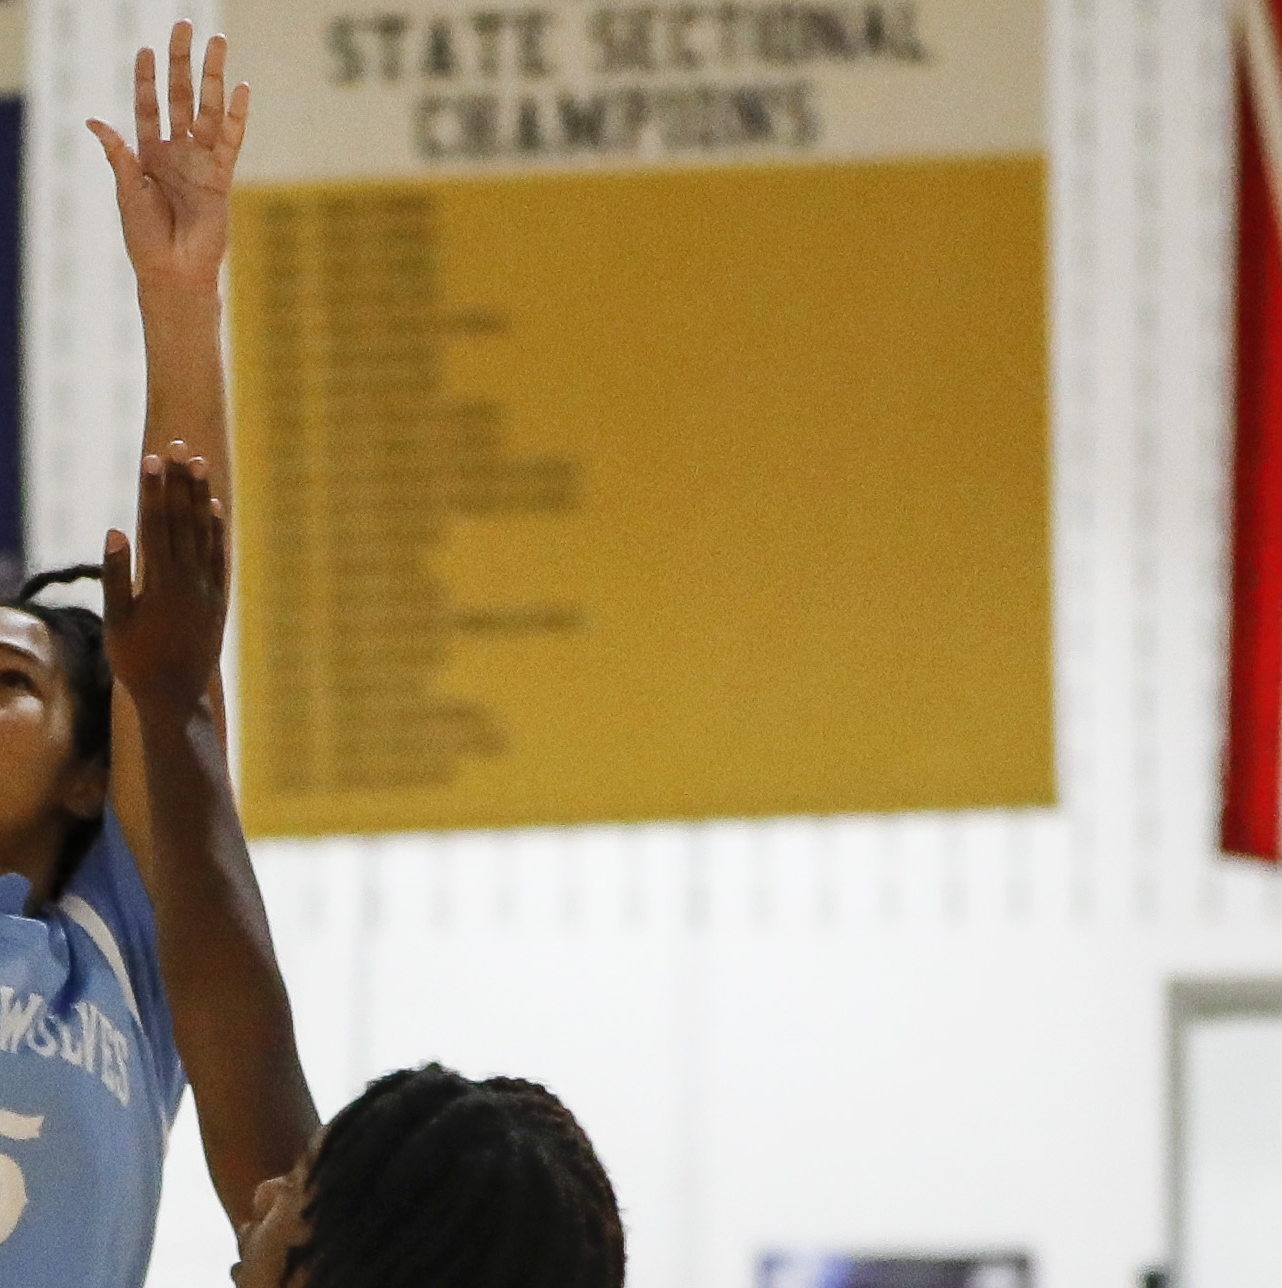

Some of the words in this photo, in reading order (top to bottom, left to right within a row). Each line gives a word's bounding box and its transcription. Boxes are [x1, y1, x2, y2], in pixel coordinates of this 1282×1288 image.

[326, 11, 550, 86] STATE
[586, 1, 932, 71] SECTIONAL
[413, 80, 823, 159] CHAMPIONS
